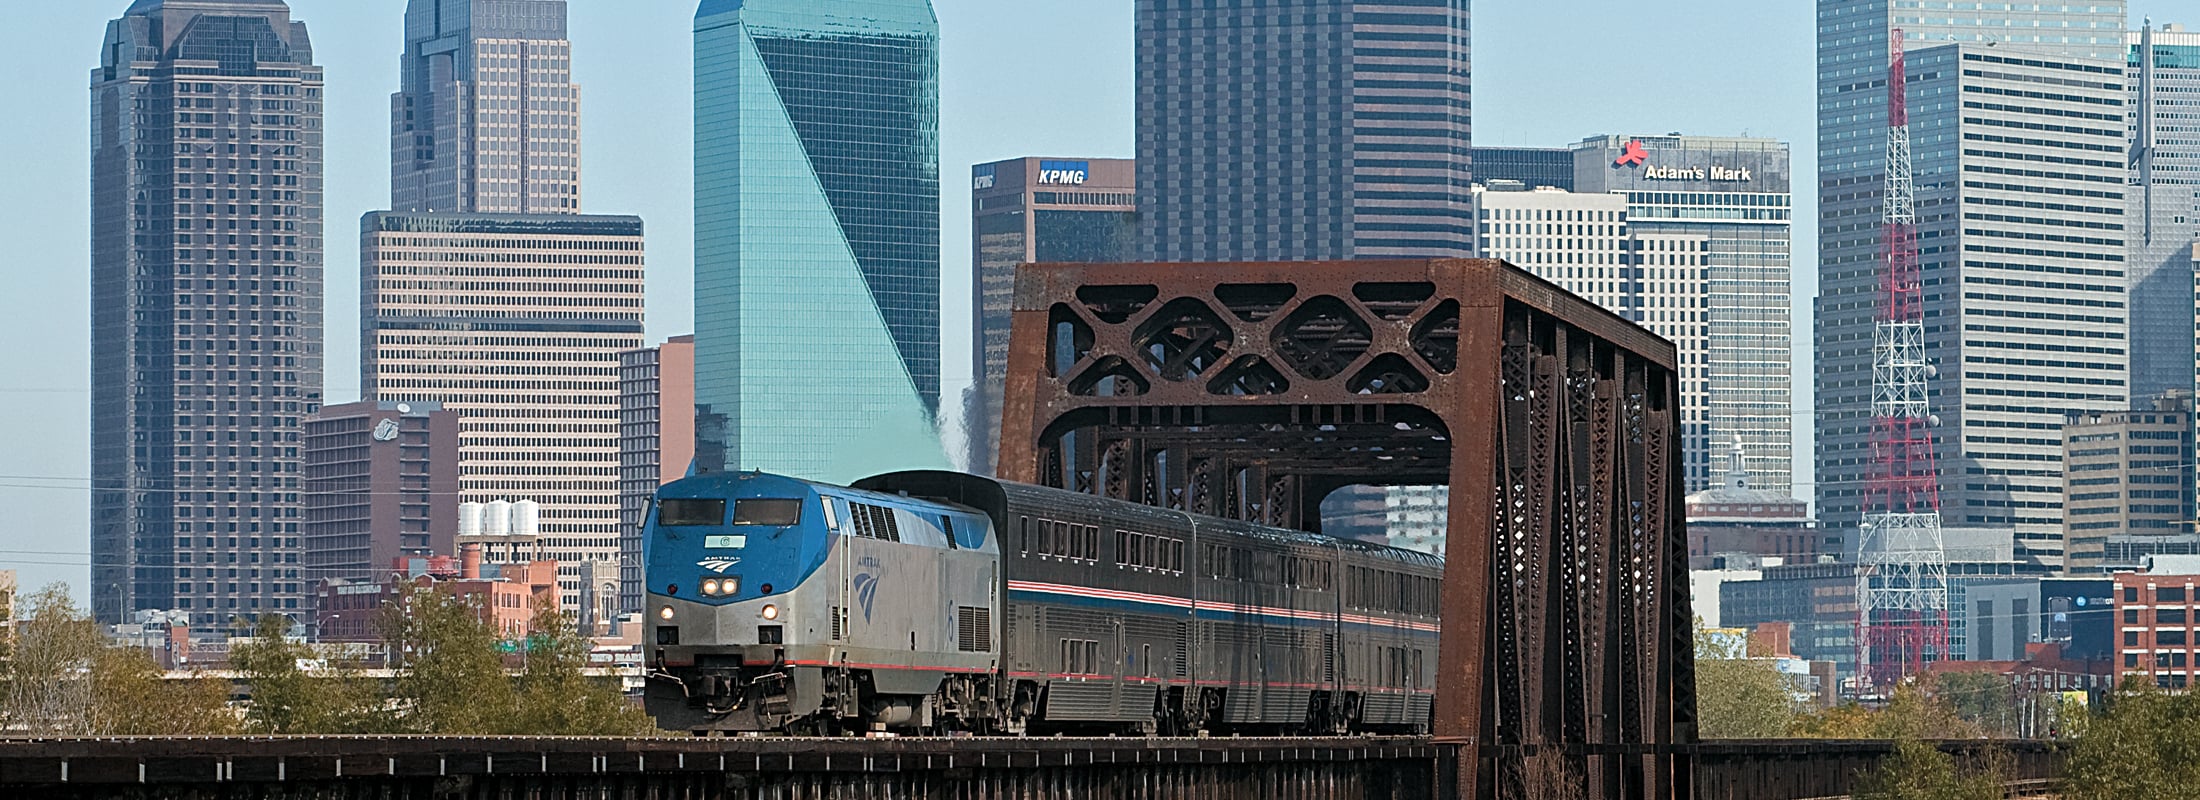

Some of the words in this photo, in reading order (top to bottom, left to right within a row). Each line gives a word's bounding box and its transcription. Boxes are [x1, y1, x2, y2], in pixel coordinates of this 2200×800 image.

[1038, 169, 1085, 184] KPMG
[1645, 165, 1705, 179] Adam's
[1710, 166, 1751, 180] Mark
[974, 175, 993, 189] KPMG
[858, 556, 880, 568] AMTRAK
[947, 599, 954, 642] 6
